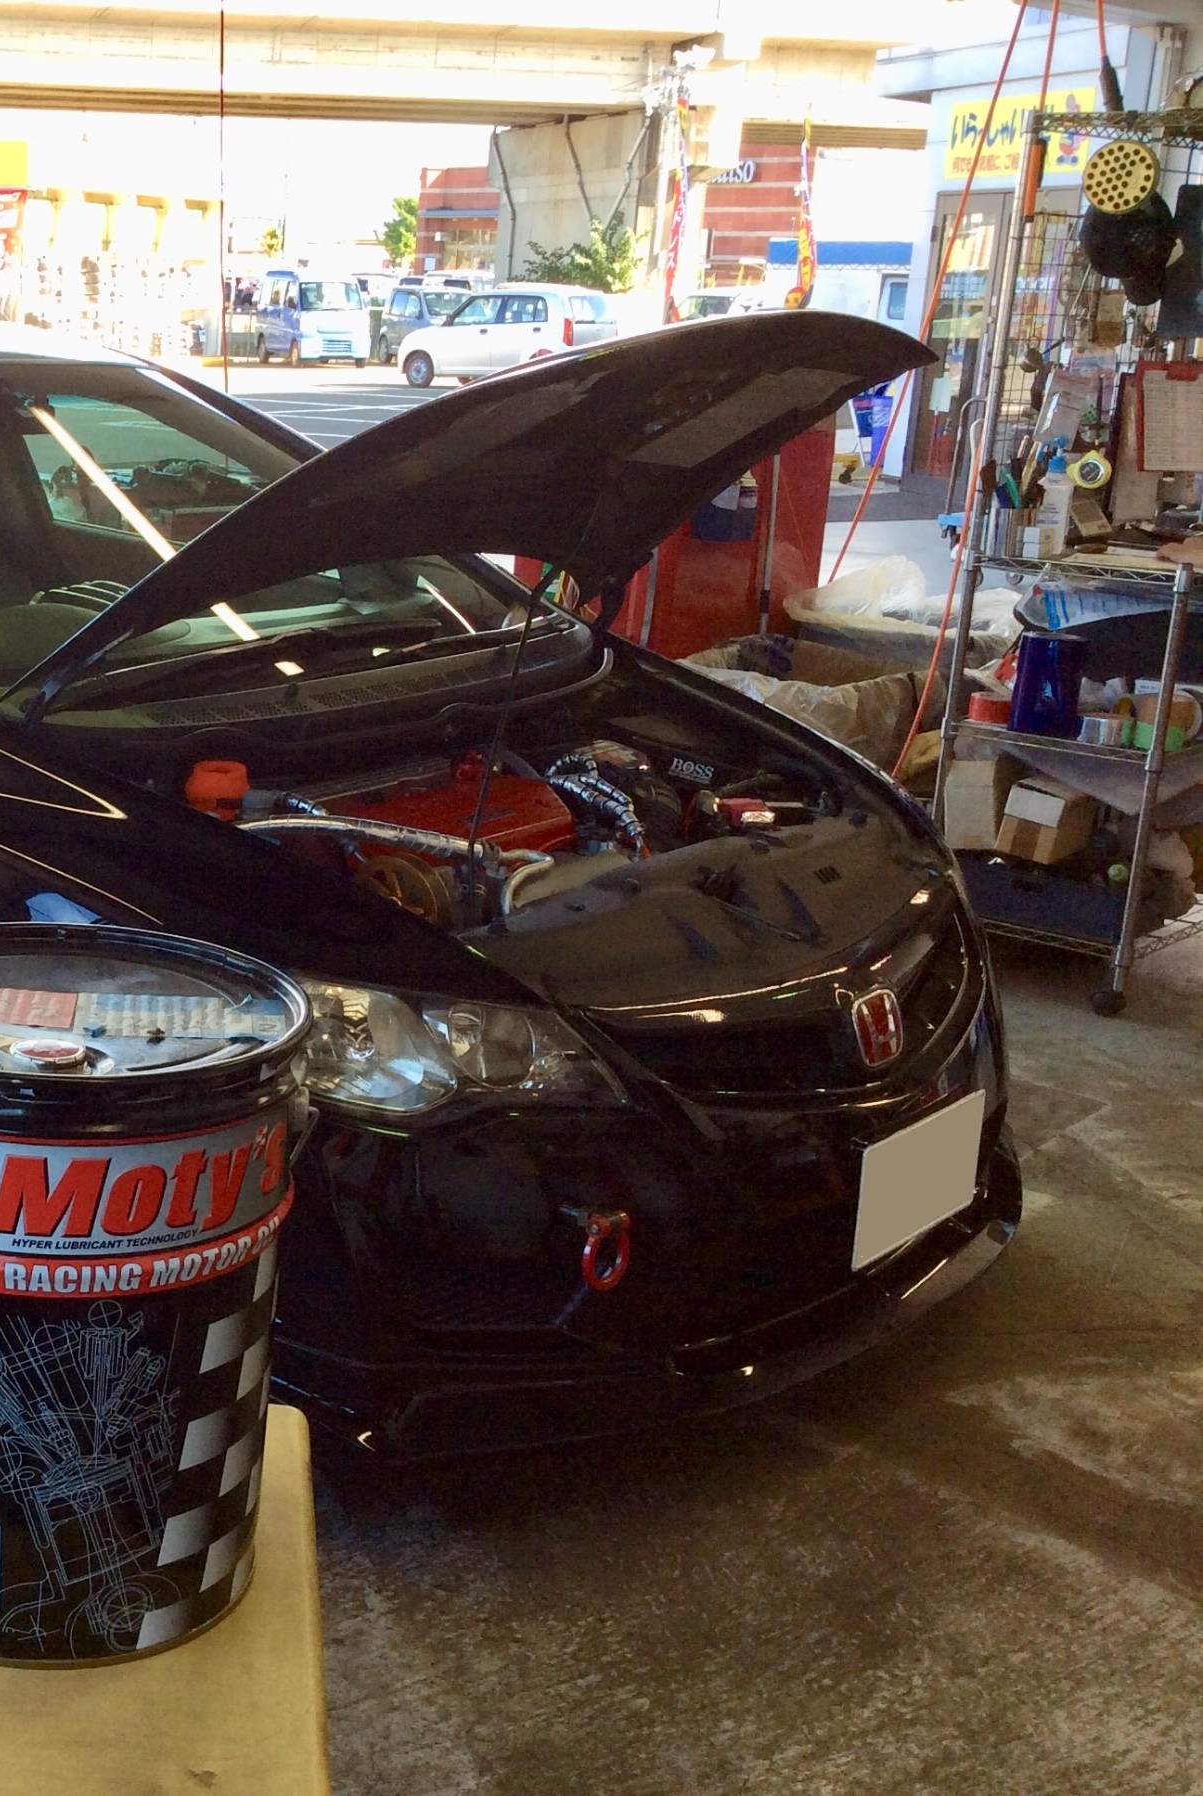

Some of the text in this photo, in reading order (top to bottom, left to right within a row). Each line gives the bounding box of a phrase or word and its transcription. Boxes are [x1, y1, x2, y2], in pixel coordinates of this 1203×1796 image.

[669, 757, 715, 779] BOSS
[12, 1228, 199, 1250] HYPER LUBRICANT TECHNOLOGY
[3, 1262, 143, 1294] RACING
[149, 1233, 253, 1288] MOTOR
